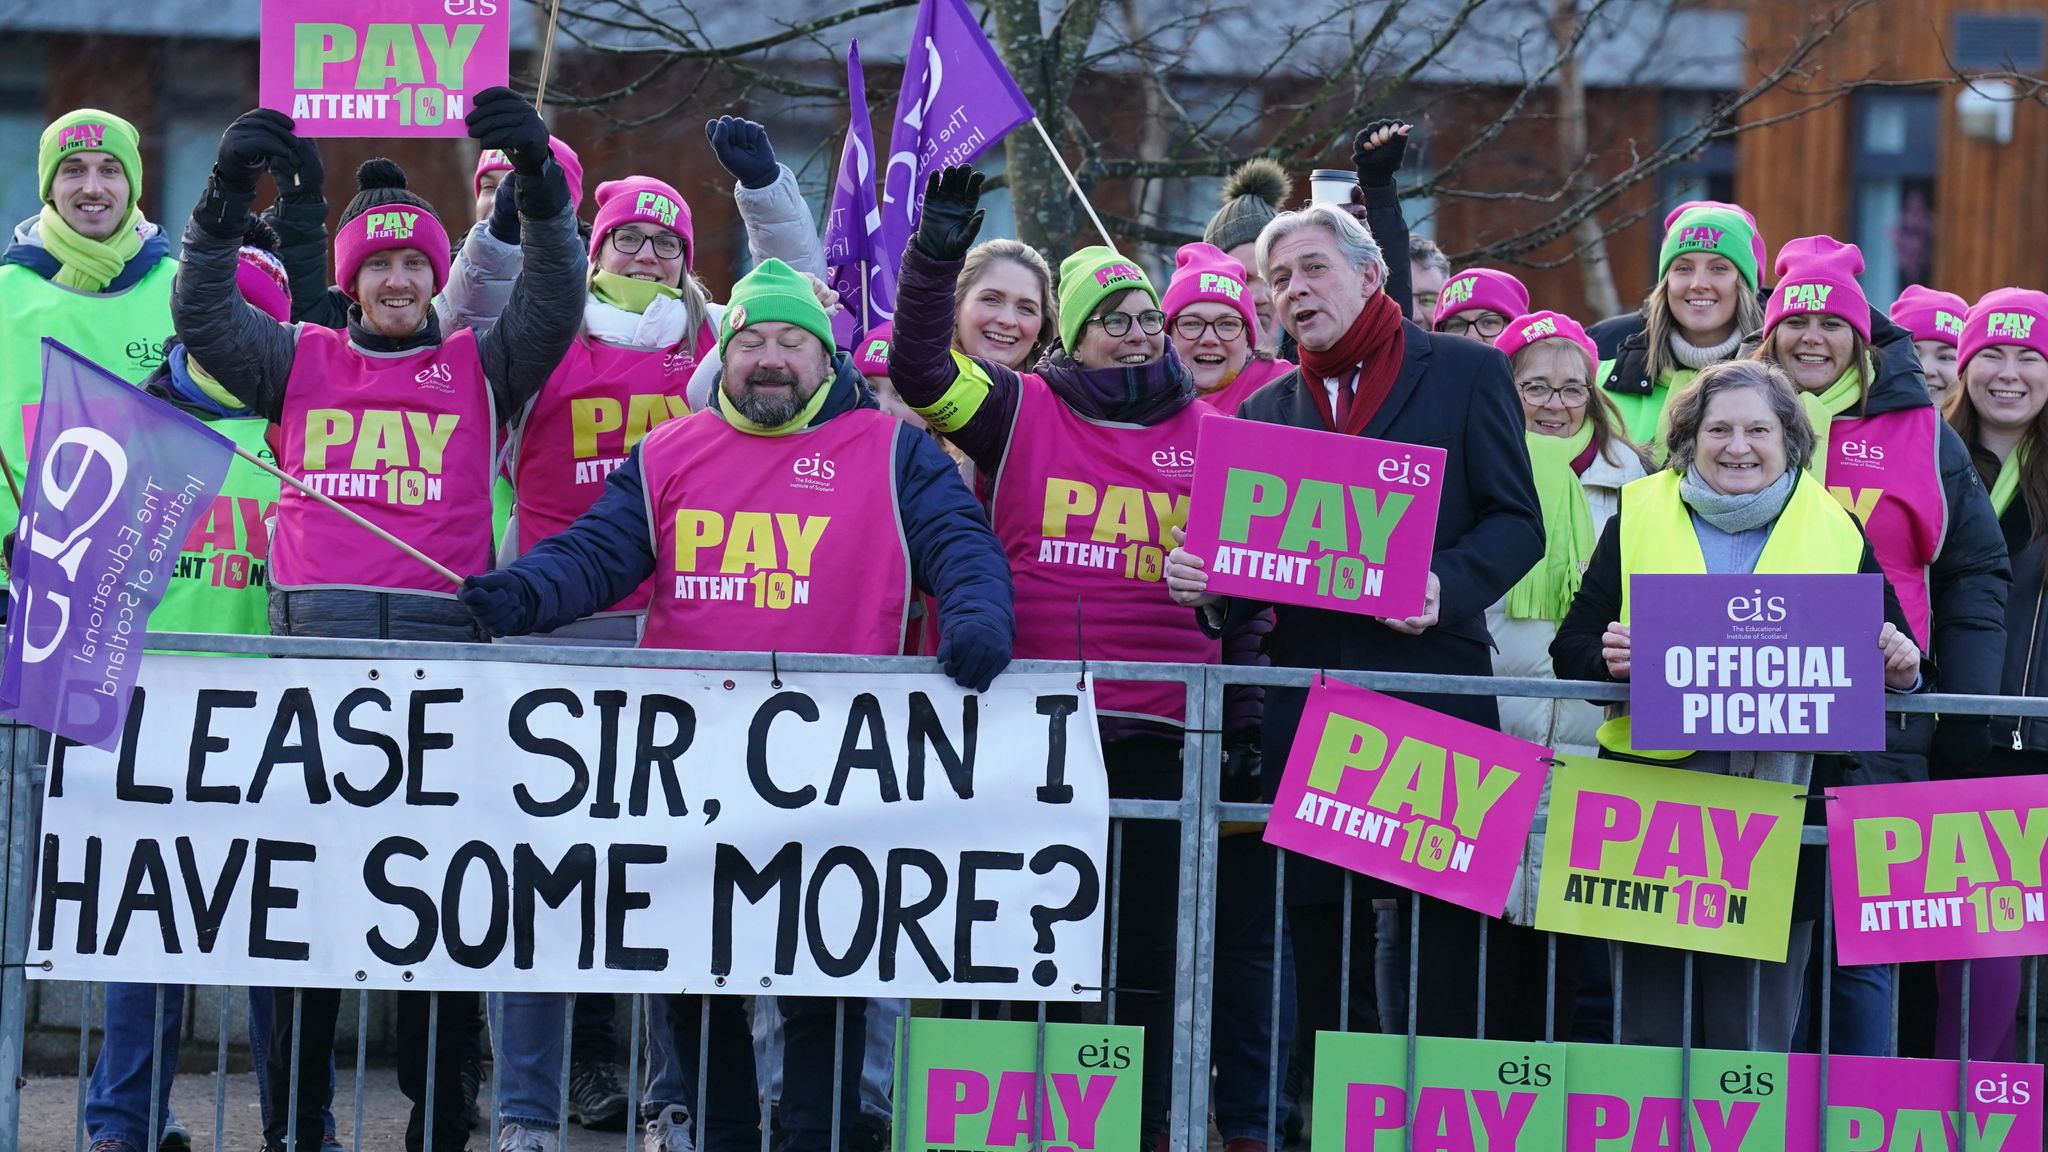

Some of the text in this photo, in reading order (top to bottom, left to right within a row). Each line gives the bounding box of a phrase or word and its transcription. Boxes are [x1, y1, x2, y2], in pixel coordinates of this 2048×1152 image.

[293, 22, 485, 90] PAY
[58, 123, 107, 147] PAY
[636, 191, 681, 219] PAY
[366, 211, 419, 234] PAY
[1679, 226, 1724, 243] PAY
[1094, 263, 1140, 285] PAY
[1199, 272, 1243, 295] PAY
[1442, 276, 1479, 304] PAY
[1783, 284, 1833, 305] PAY
[1521, 317, 1556, 338] PAY
[1987, 312, 2036, 332] PAY
[303, 408, 461, 475] PAY
[1151, 446, 1195, 467] eis
[1841, 439, 1884, 460] eis
[793, 452, 835, 480] eis
[1377, 454, 1430, 487] eis
[1042, 477, 1192, 552] PAY
[1218, 467, 1416, 565] PAY
[675, 508, 832, 577] PAY
[1727, 588, 1787, 622] eis
[1760, 633, 1788, 641] Scotland
[1665, 645, 1852, 688] OFFICIAL
[1683, 692, 1835, 735] PICKET
[509, 687, 721, 826] SIR,
[747, 691, 979, 809] CAN
[1035, 694, 1079, 804] I
[1306, 711, 1521, 840] PAY
[1568, 790, 1780, 890] PAY
[1853, 807, 2048, 898] PAY
[37, 833, 1100, 987] HAVE SOME MORE?
[1078, 1038, 1131, 1070] eis
[1498, 1055, 1552, 1087] eis
[1719, 1064, 1774, 1096] eis
[1974, 1073, 2030, 1105] eis
[925, 1068, 1118, 1150] PAY
[1344, 1082, 1539, 1152] PAY
[1565, 1092, 1761, 1152] PAY
